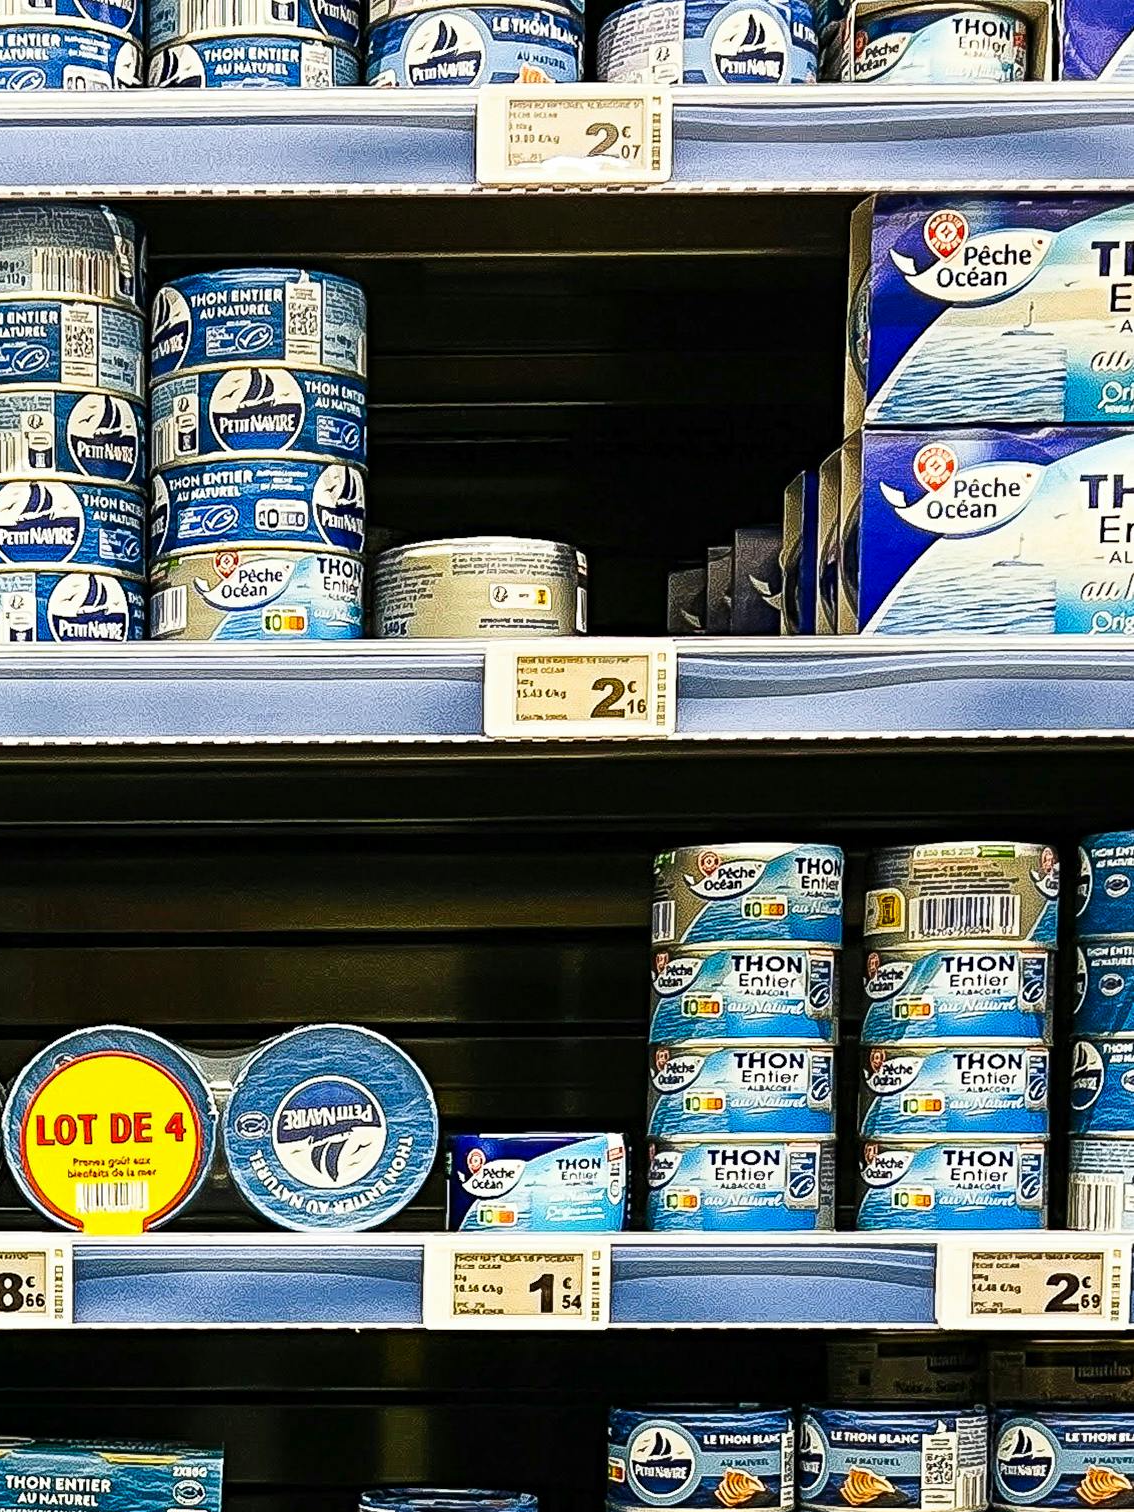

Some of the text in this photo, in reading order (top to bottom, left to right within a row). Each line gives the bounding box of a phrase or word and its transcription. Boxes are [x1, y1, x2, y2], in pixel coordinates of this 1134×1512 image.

[951, 18, 1011, 39] THON
[204, 48, 300, 62] THON ENTIER
[215, 63, 288, 75] AU NATUREL
[585, 123, 641, 159] 2 07
[964, 244, 1032, 267] Pêche
[937, 267, 1007, 288] Océan
[191, 289, 282, 307] THON ENTIER
[201, 304, 272, 319] AU NATUREL
[954, 477, 1020, 499] Pêche
[927, 499, 997, 520] Océan
[239, 568, 283, 586] Pêche
[222, 584, 267, 599] Océan
[590, 678, 647, 718] 2 16
[718, 865, 755, 879] Pêche
[704, 878, 743, 891] Océan
[732, 956, 802, 973] THON
[941, 956, 1014, 973] THON
[740, 973, 797, 987] Entier
[949, 972, 1008, 987] Entier
[734, 1053, 804, 1070] THON
[742, 1070, 799, 1084] Entier
[37, 1113, 186, 1145] LOT DE 4
[556, 1158, 601, 1170] THON
[943, 1151, 1014, 1167] THON
[482, 1167, 515, 1180] Pêche
[951, 1167, 1008, 1183] Entier
[472, 1178, 503, 1190] Océan
[26, 1293, 45, 1308] 66
[530, 1273, 581, 1313] 1 54
[1045, 1273, 1100, 1312] 2 69
[847, 1432, 877, 1443] THON
